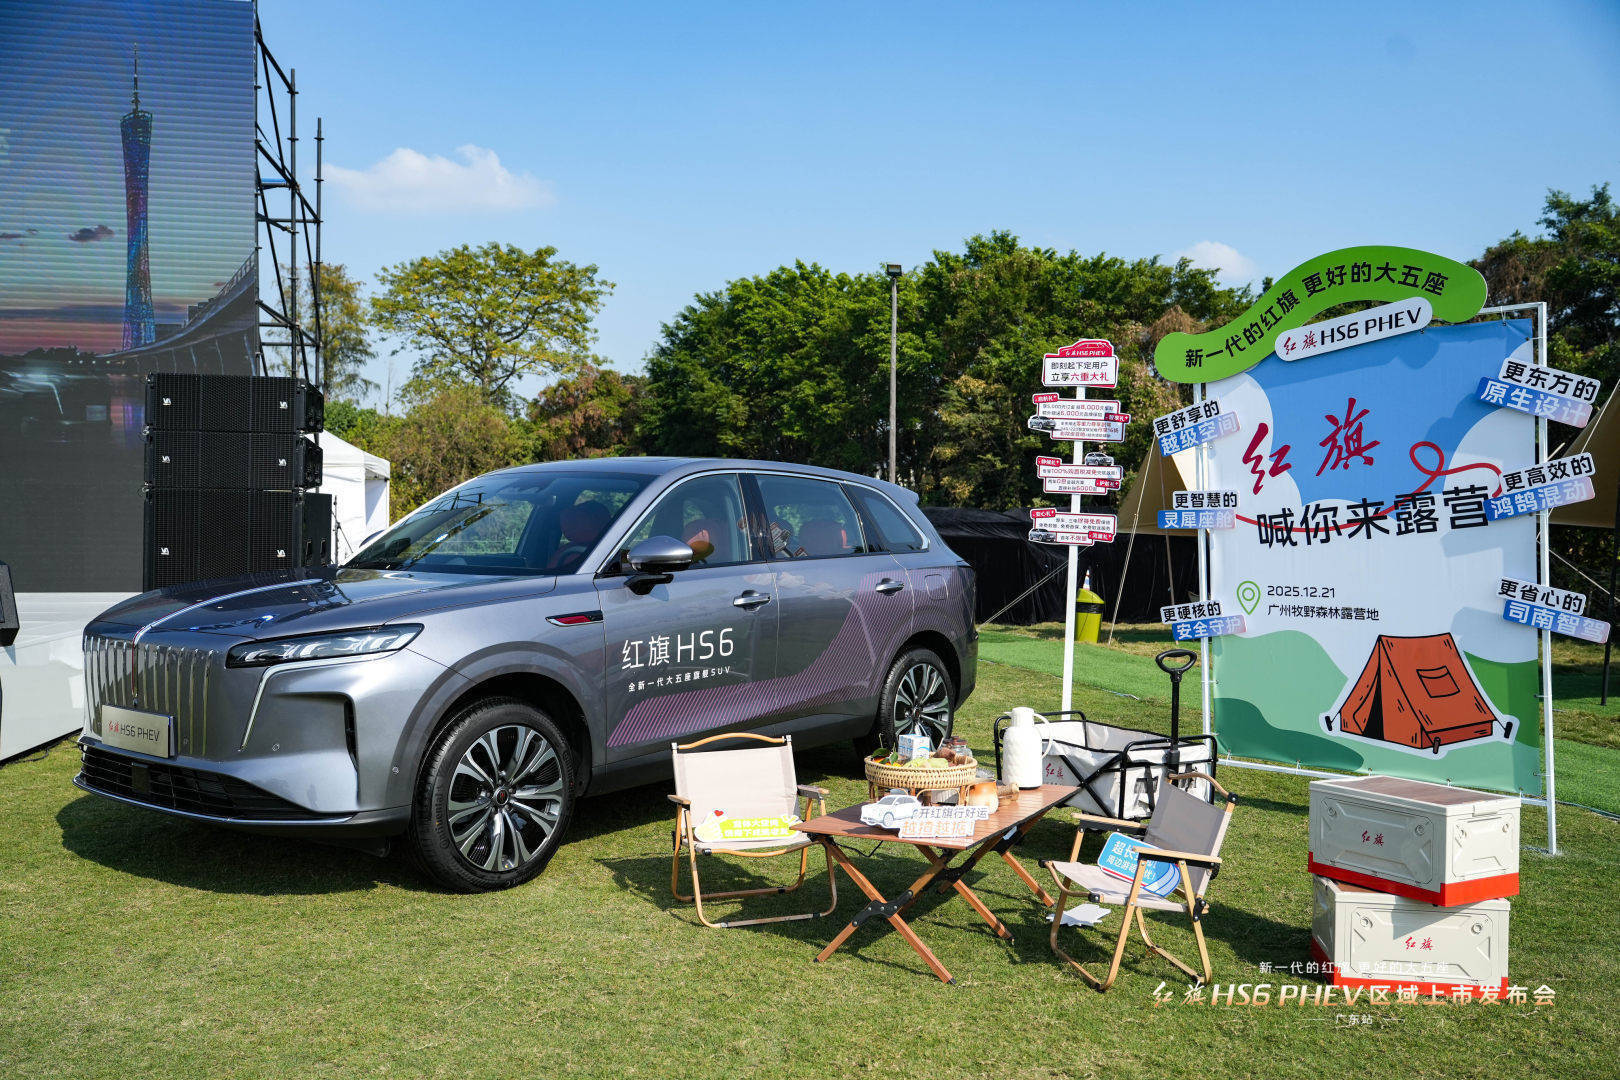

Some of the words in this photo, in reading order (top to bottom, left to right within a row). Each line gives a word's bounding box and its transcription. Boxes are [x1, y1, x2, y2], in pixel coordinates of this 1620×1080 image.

[1184, 289, 1301, 370] 新一代的红旗
[1302, 260, 1449, 298] 更好的大五座
[1364, 306, 1422, 337] PHEV
[1051, 361, 1108, 370] 即刻起下定用户
[1051, 372, 1110, 382] 立享六重大礼
[1504, 360, 1598, 402] 更东方的
[1154, 399, 1221, 435] 更舒享的
[1480, 379, 1588, 423] 原生设计
[1160, 412, 1239, 456] 越级空间
[1242, 398, 1381, 496] 红旗
[1503, 456, 1594, 492] 更高效的
[1174, 492, 1239, 510] 更智慧的
[1490, 478, 1589, 519] 鸿鹄混动
[1163, 510, 1236, 530] 灵犀座舱
[1257, 484, 1490, 549] 喊你来露营
[1267, 584, 1336, 599] 2025.12.21
[1500, 578, 1584, 612] 更省心的
[1162, 601, 1223, 622] 更硬核的
[1176, 615, 1243, 640] 安全守护
[1267, 603, 1380, 622] 广州牧野森林露营地
[1507, 600, 1607, 642] 司南智驾
[137, 727, 160, 742] PHEV
[1404, 935, 1435, 951] 红旗
